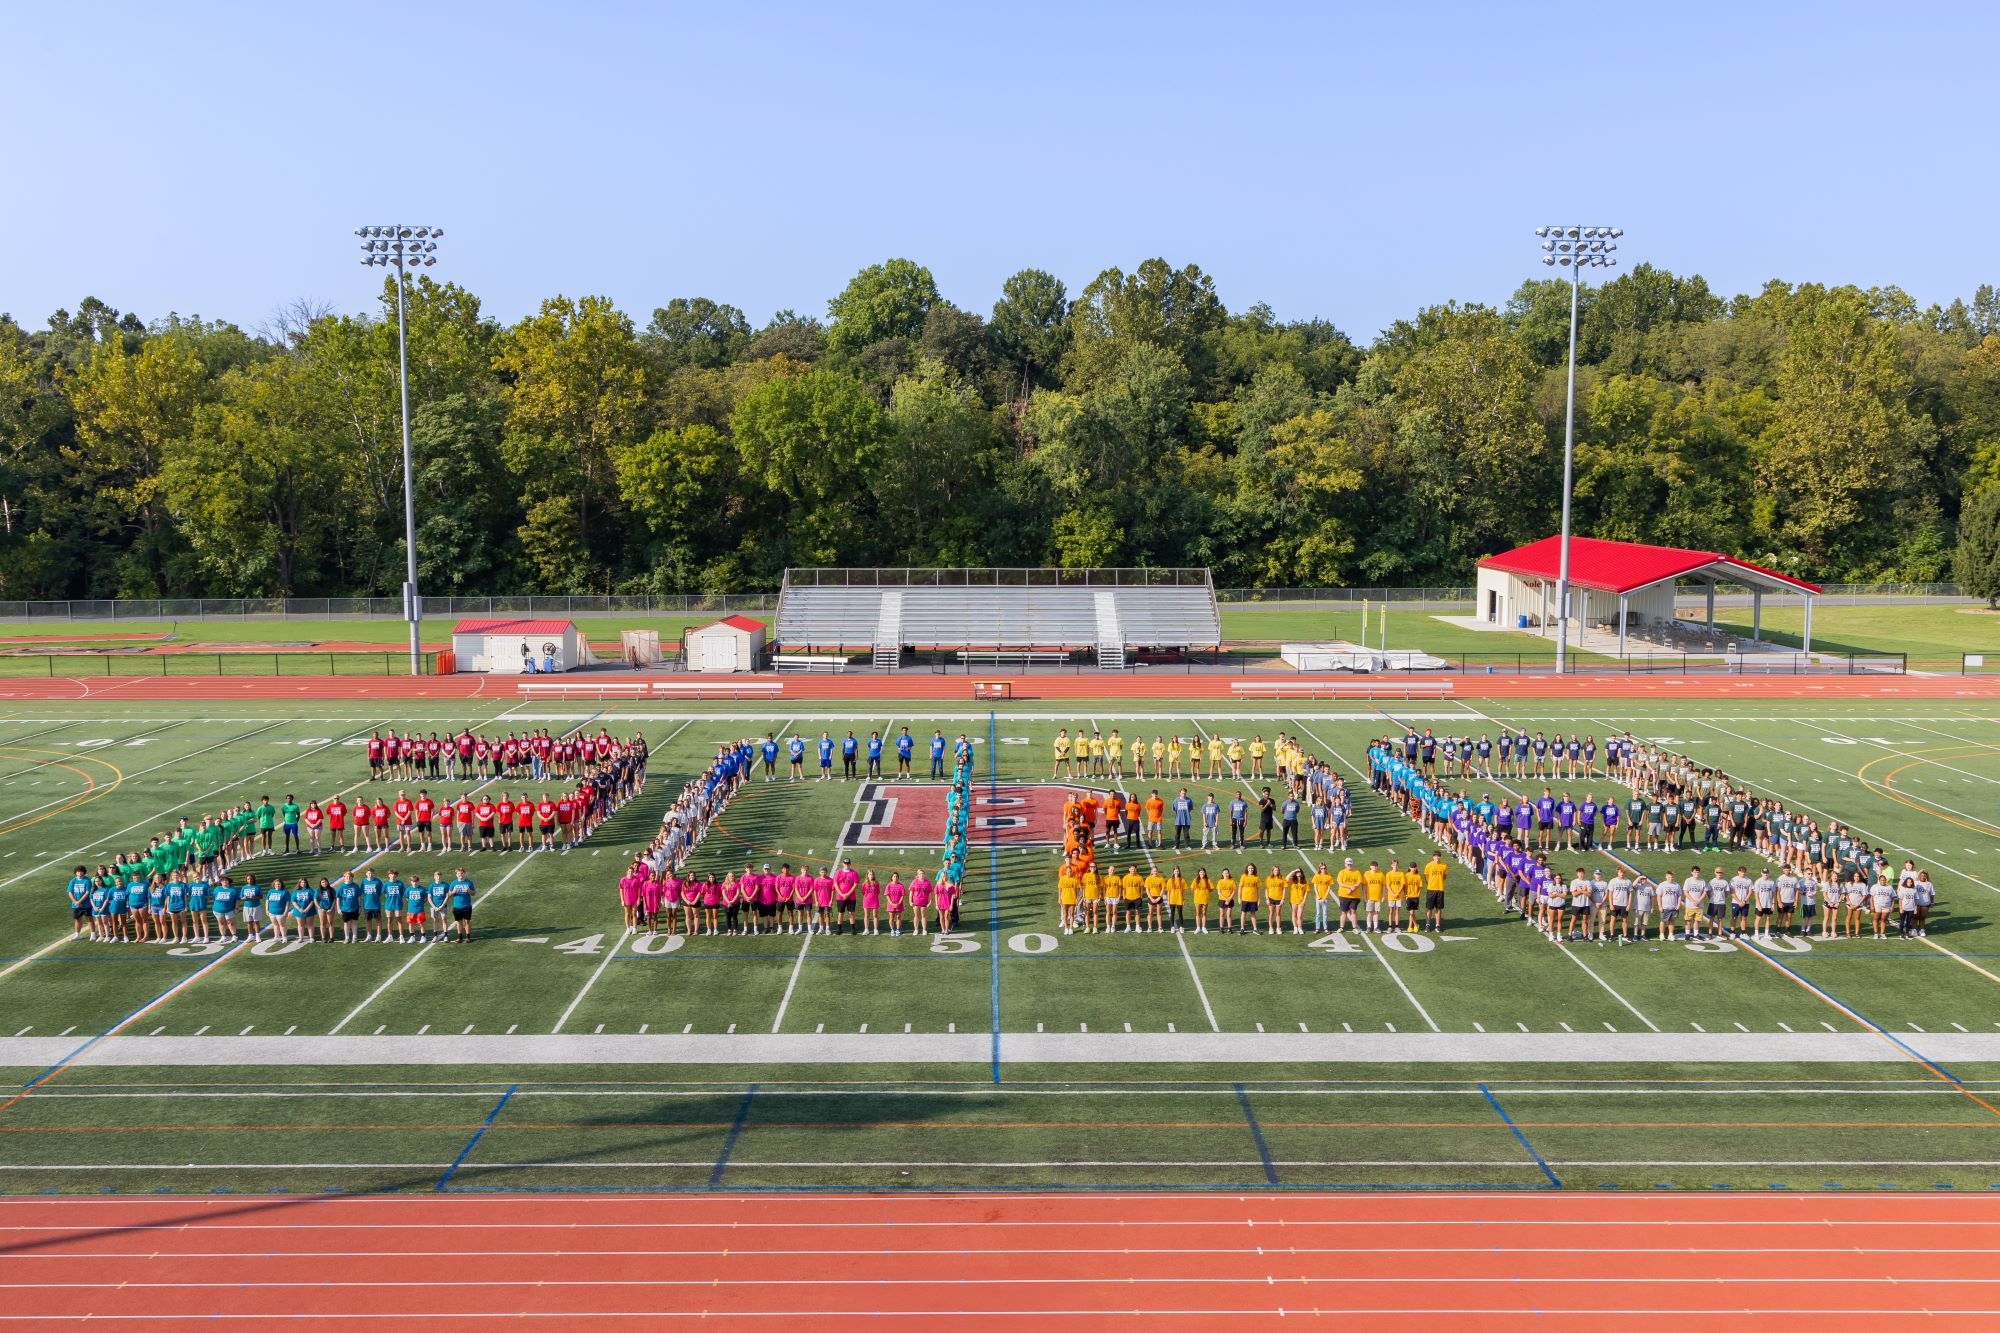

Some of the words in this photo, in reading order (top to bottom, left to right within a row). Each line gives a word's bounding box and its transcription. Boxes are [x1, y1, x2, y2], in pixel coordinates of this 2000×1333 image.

[553, 933, 685, 954] 40
[929, 933, 1058, 954] 50
[1307, 932, 1435, 953] 40
